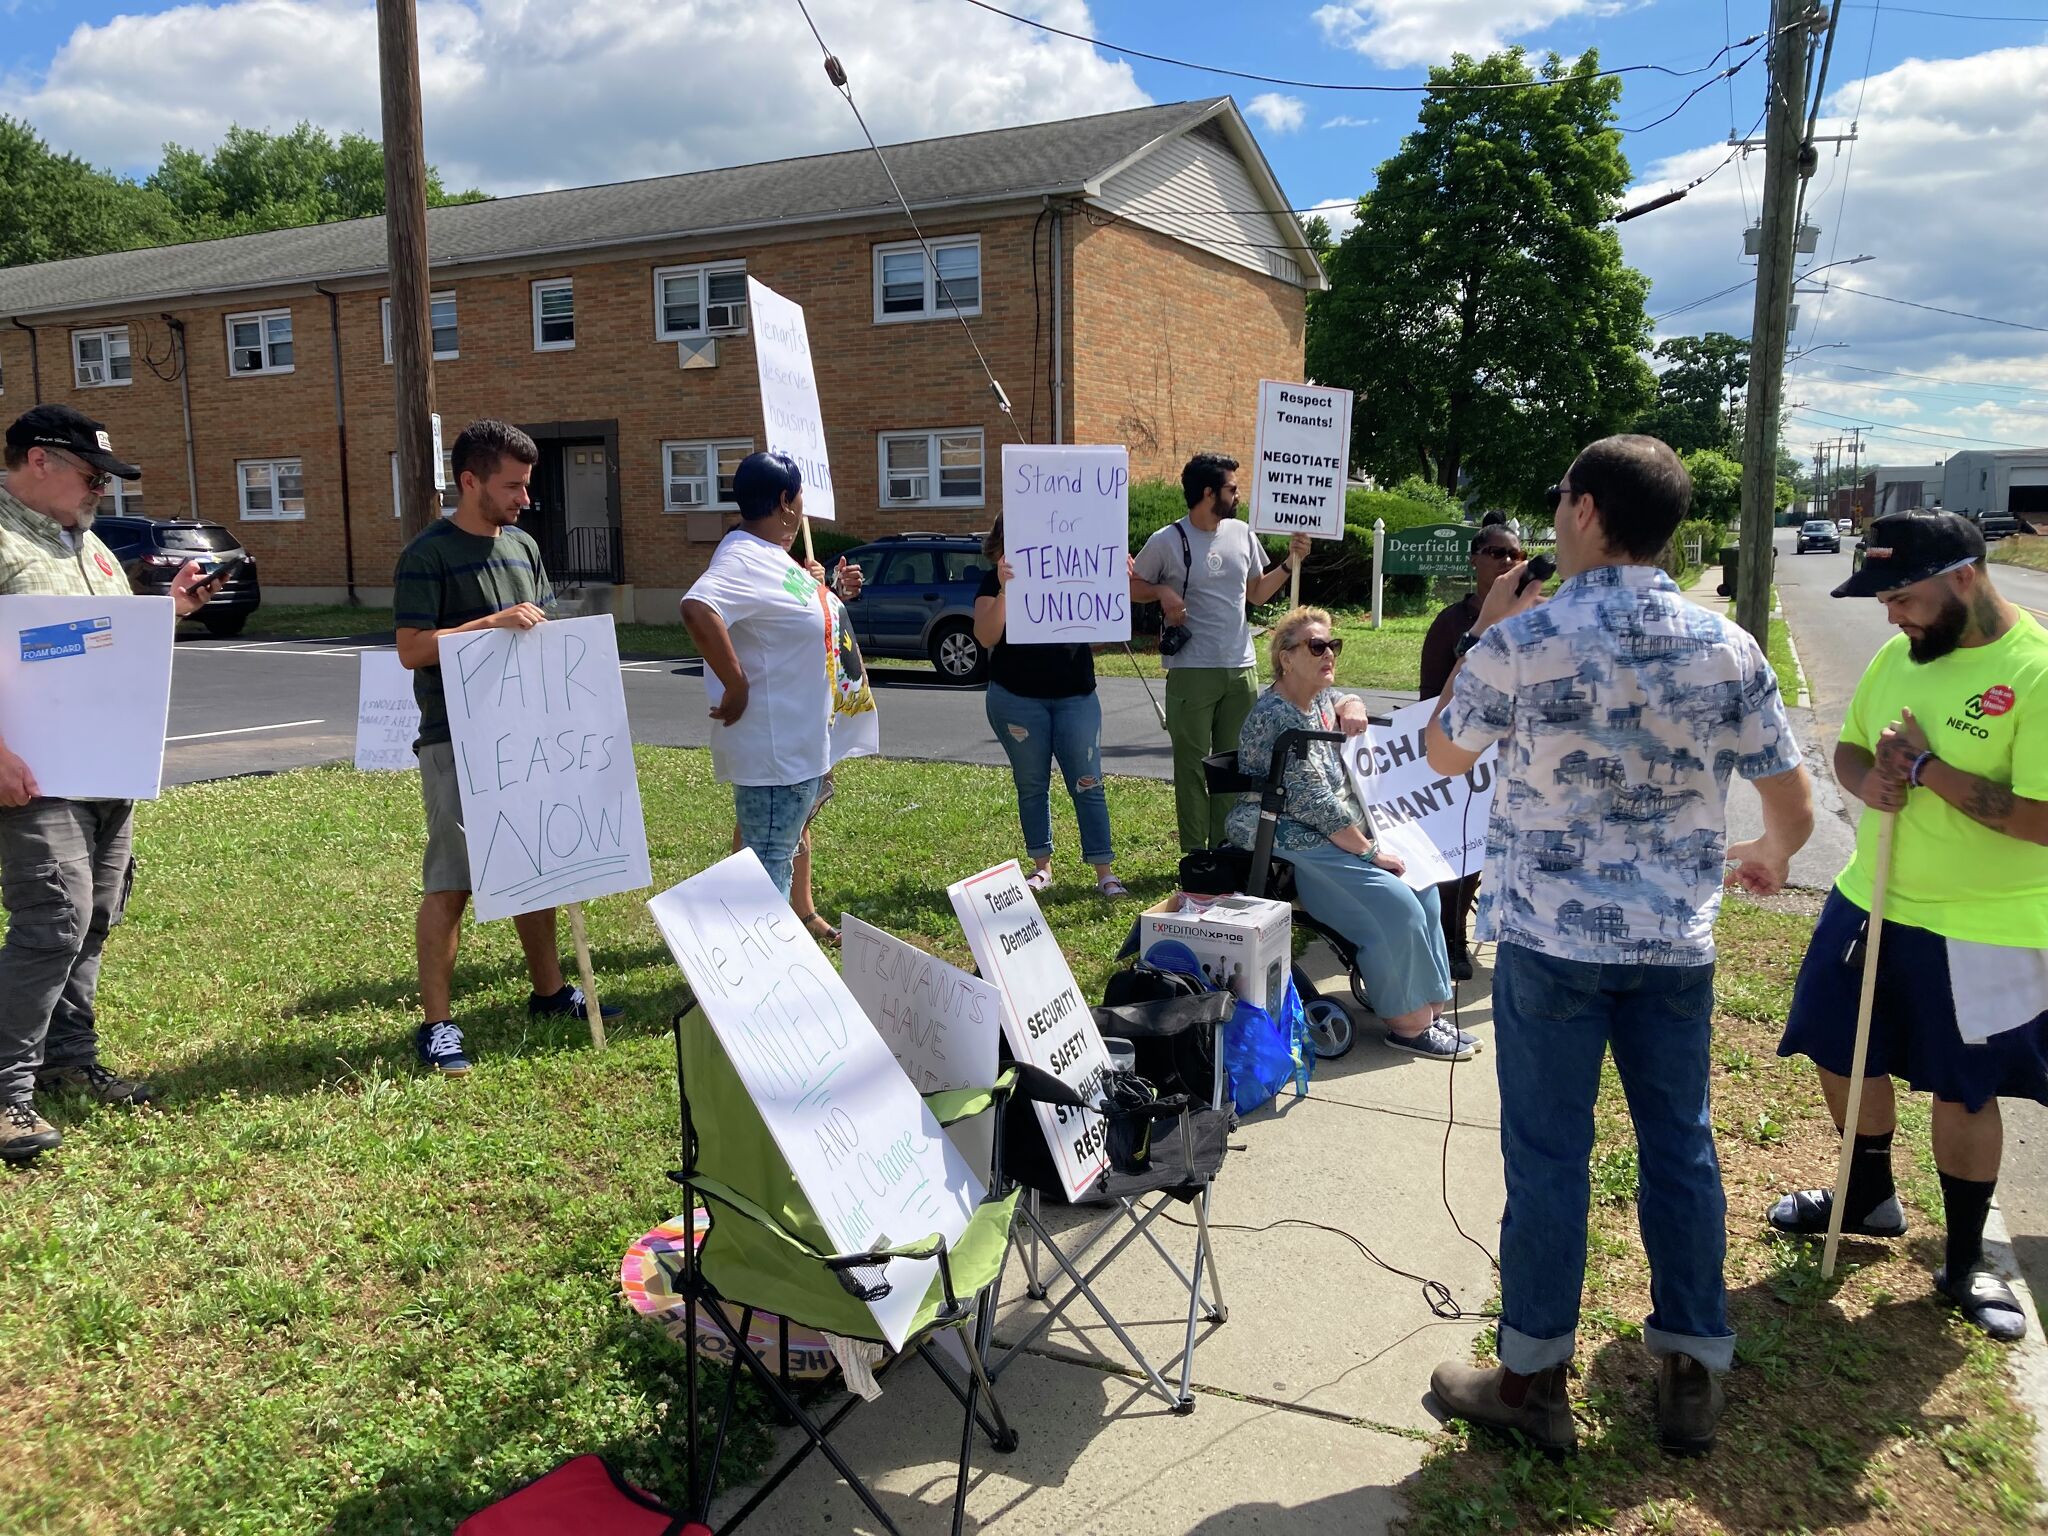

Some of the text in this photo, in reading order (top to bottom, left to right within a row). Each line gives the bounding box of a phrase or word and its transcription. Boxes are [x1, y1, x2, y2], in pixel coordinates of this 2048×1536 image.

[762, 357, 810, 390] deserve
[1280, 391, 1332, 408] Respect
[767, 397, 816, 449] housing
[1277, 411, 1332, 428] Tenants!
[1263, 450, 1339, 469] NEGOTIATE
[1015, 464, 1127, 499] Stand UP
[1268, 471, 1333, 488] WITH THE
[1272, 492, 1326, 507] TENANT
[1047, 510, 1082, 534] for
[1274, 512, 1321, 527] UNION!
[1015, 544, 1119, 579] TENANT
[1388, 539, 1459, 552] Deerfield
[1400, 554, 1471, 562] APARTMEN
[1025, 591, 1125, 623] UNIONS
[23, 643, 81, 659] FOAM BOARD
[457, 630, 597, 719] FAIR
[1946, 716, 1989, 739] NEFCO
[461, 729, 614, 795] LEASES
[1367, 776, 1455, 832] ENANT
[478, 791, 623, 892] NOW
[984, 882, 1023, 914] Tenants
[668, 898, 796, 1000] We Are
[999, 916, 1042, 955] Demand:
[853, 932, 987, 1024] TENANTS
[878, 993, 947, 1060] HAVE
[1027, 986, 1077, 1040] SECURITY
[727, 963, 848, 1100] UNITED
[1050, 1028, 1088, 1075] SAFETY
[814, 1107, 859, 1171] AND
[857, 1130, 929, 1198] Change
